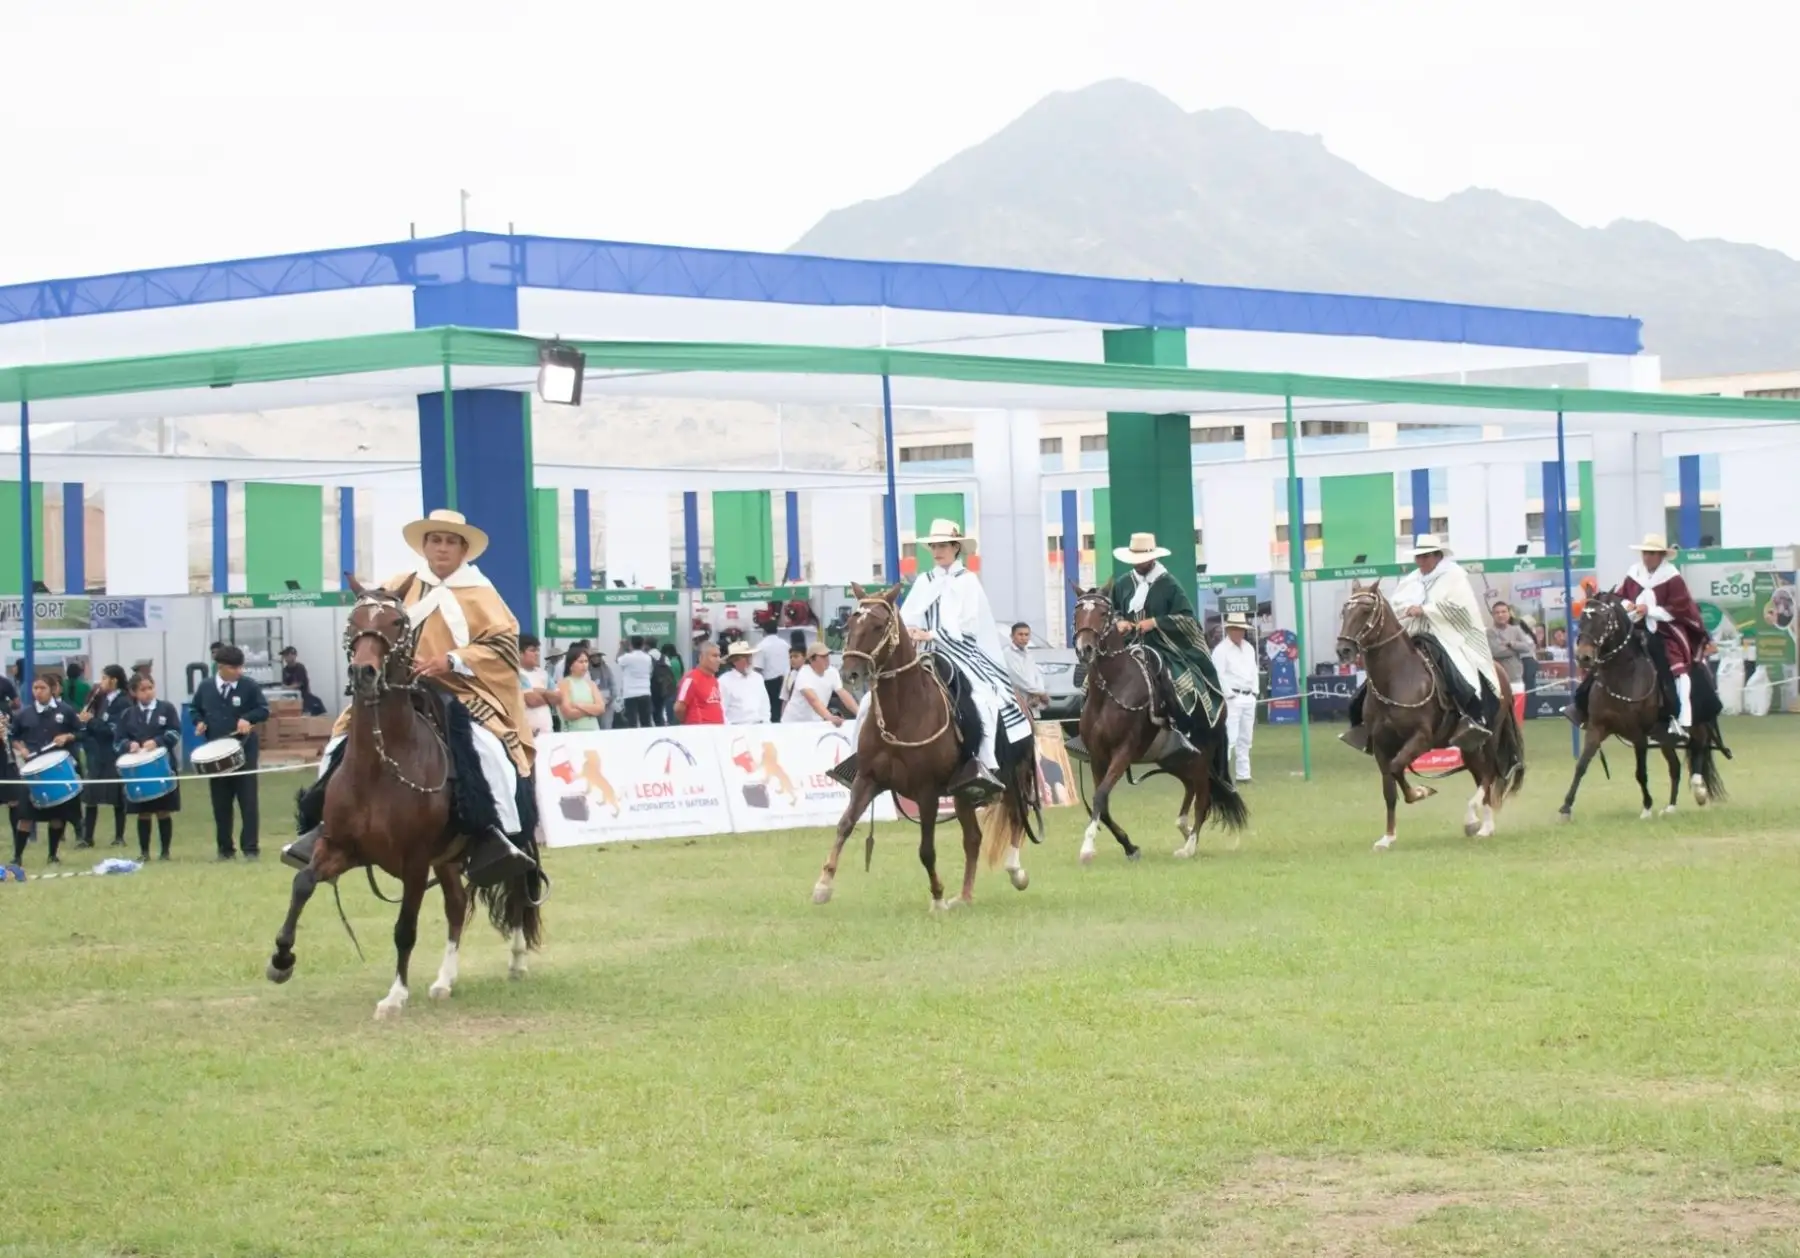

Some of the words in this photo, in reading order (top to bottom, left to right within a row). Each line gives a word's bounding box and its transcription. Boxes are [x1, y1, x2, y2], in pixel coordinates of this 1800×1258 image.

[7, 602, 65, 618] IMORT
[1226, 603, 1250, 612] LOTES
[808, 773, 839, 788] LEO
[634, 780, 675, 799] LEON
